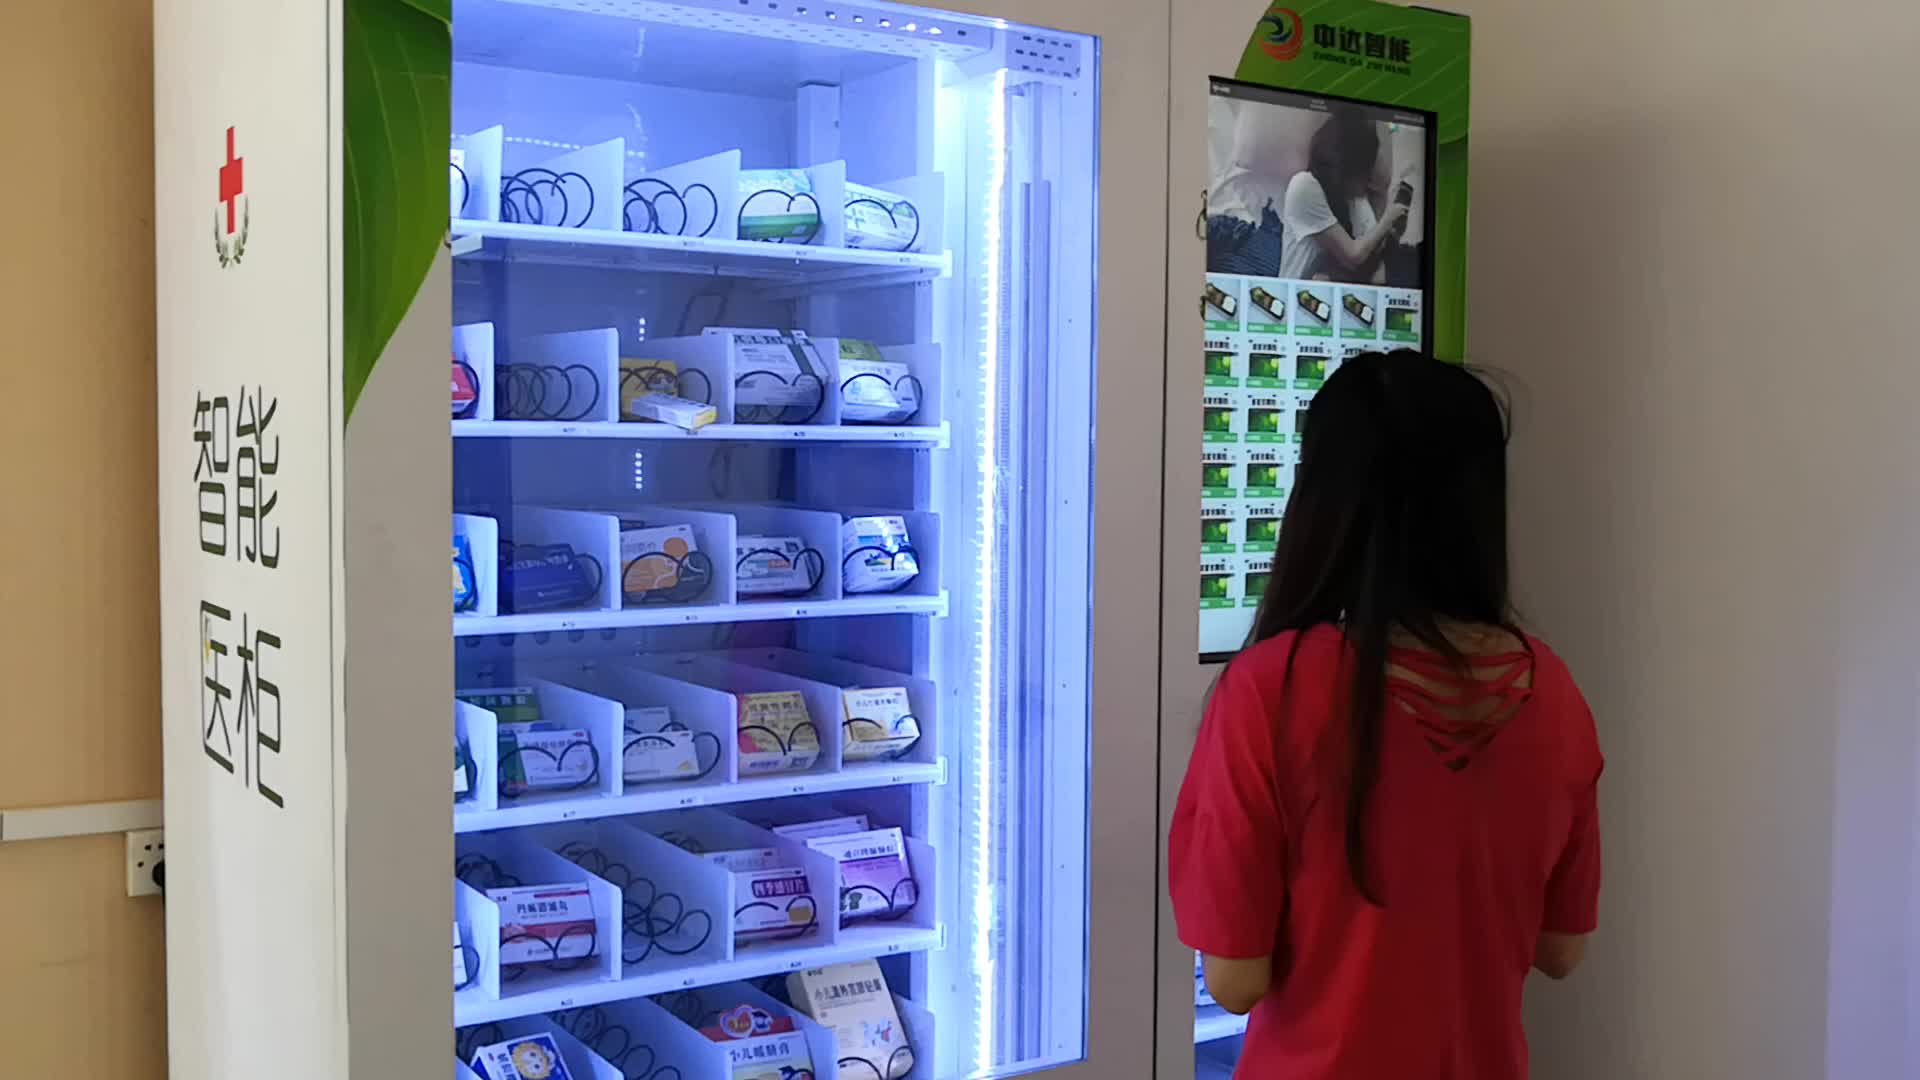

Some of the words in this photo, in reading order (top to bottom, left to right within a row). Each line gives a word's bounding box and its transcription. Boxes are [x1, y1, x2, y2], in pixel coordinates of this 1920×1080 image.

[1313, 23, 1411, 63] 中达智能
[194, 384, 280, 569] 智能
[200, 600, 284, 809] 医柜
